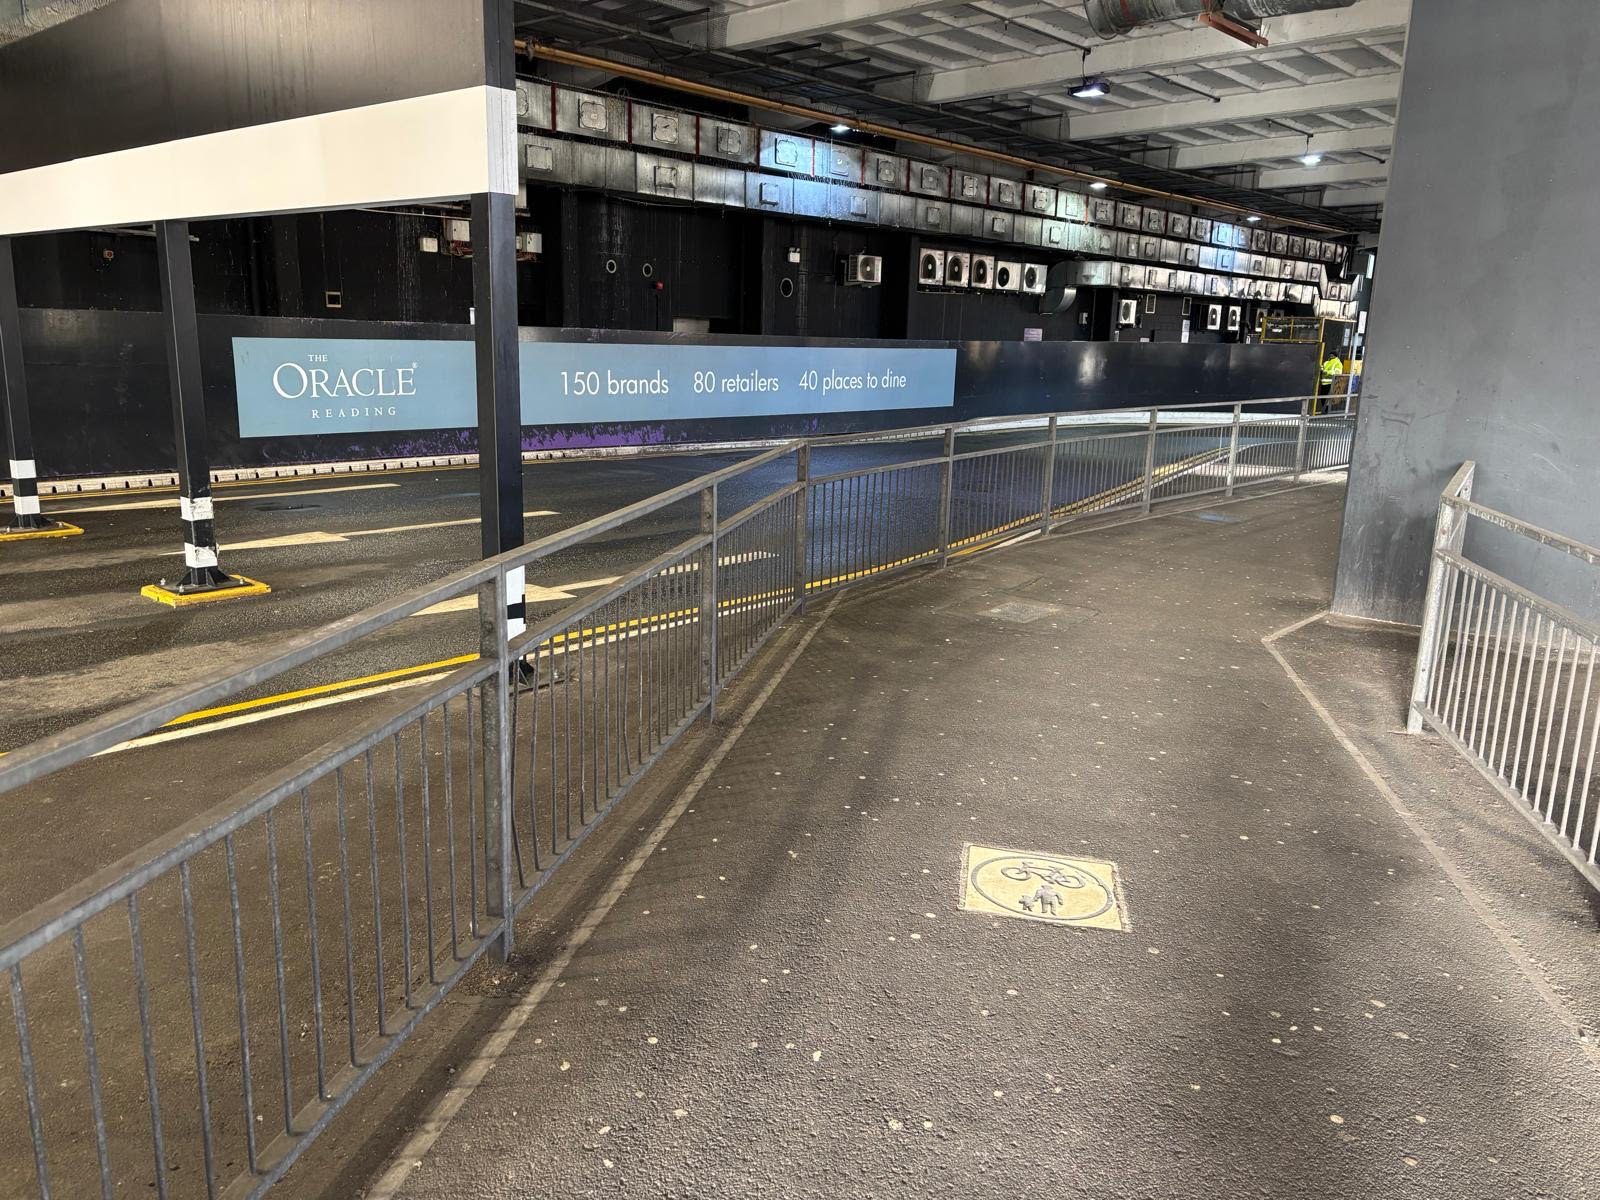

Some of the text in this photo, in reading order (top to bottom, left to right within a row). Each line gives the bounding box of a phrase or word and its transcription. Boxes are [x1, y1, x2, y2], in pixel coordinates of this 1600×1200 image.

[308, 354, 328, 362] THE
[272, 362, 416, 399] ORACLE
[560, 368, 907, 395] 150 brands 80 retailers 40 places to dine
[311, 407, 396, 419] READING
